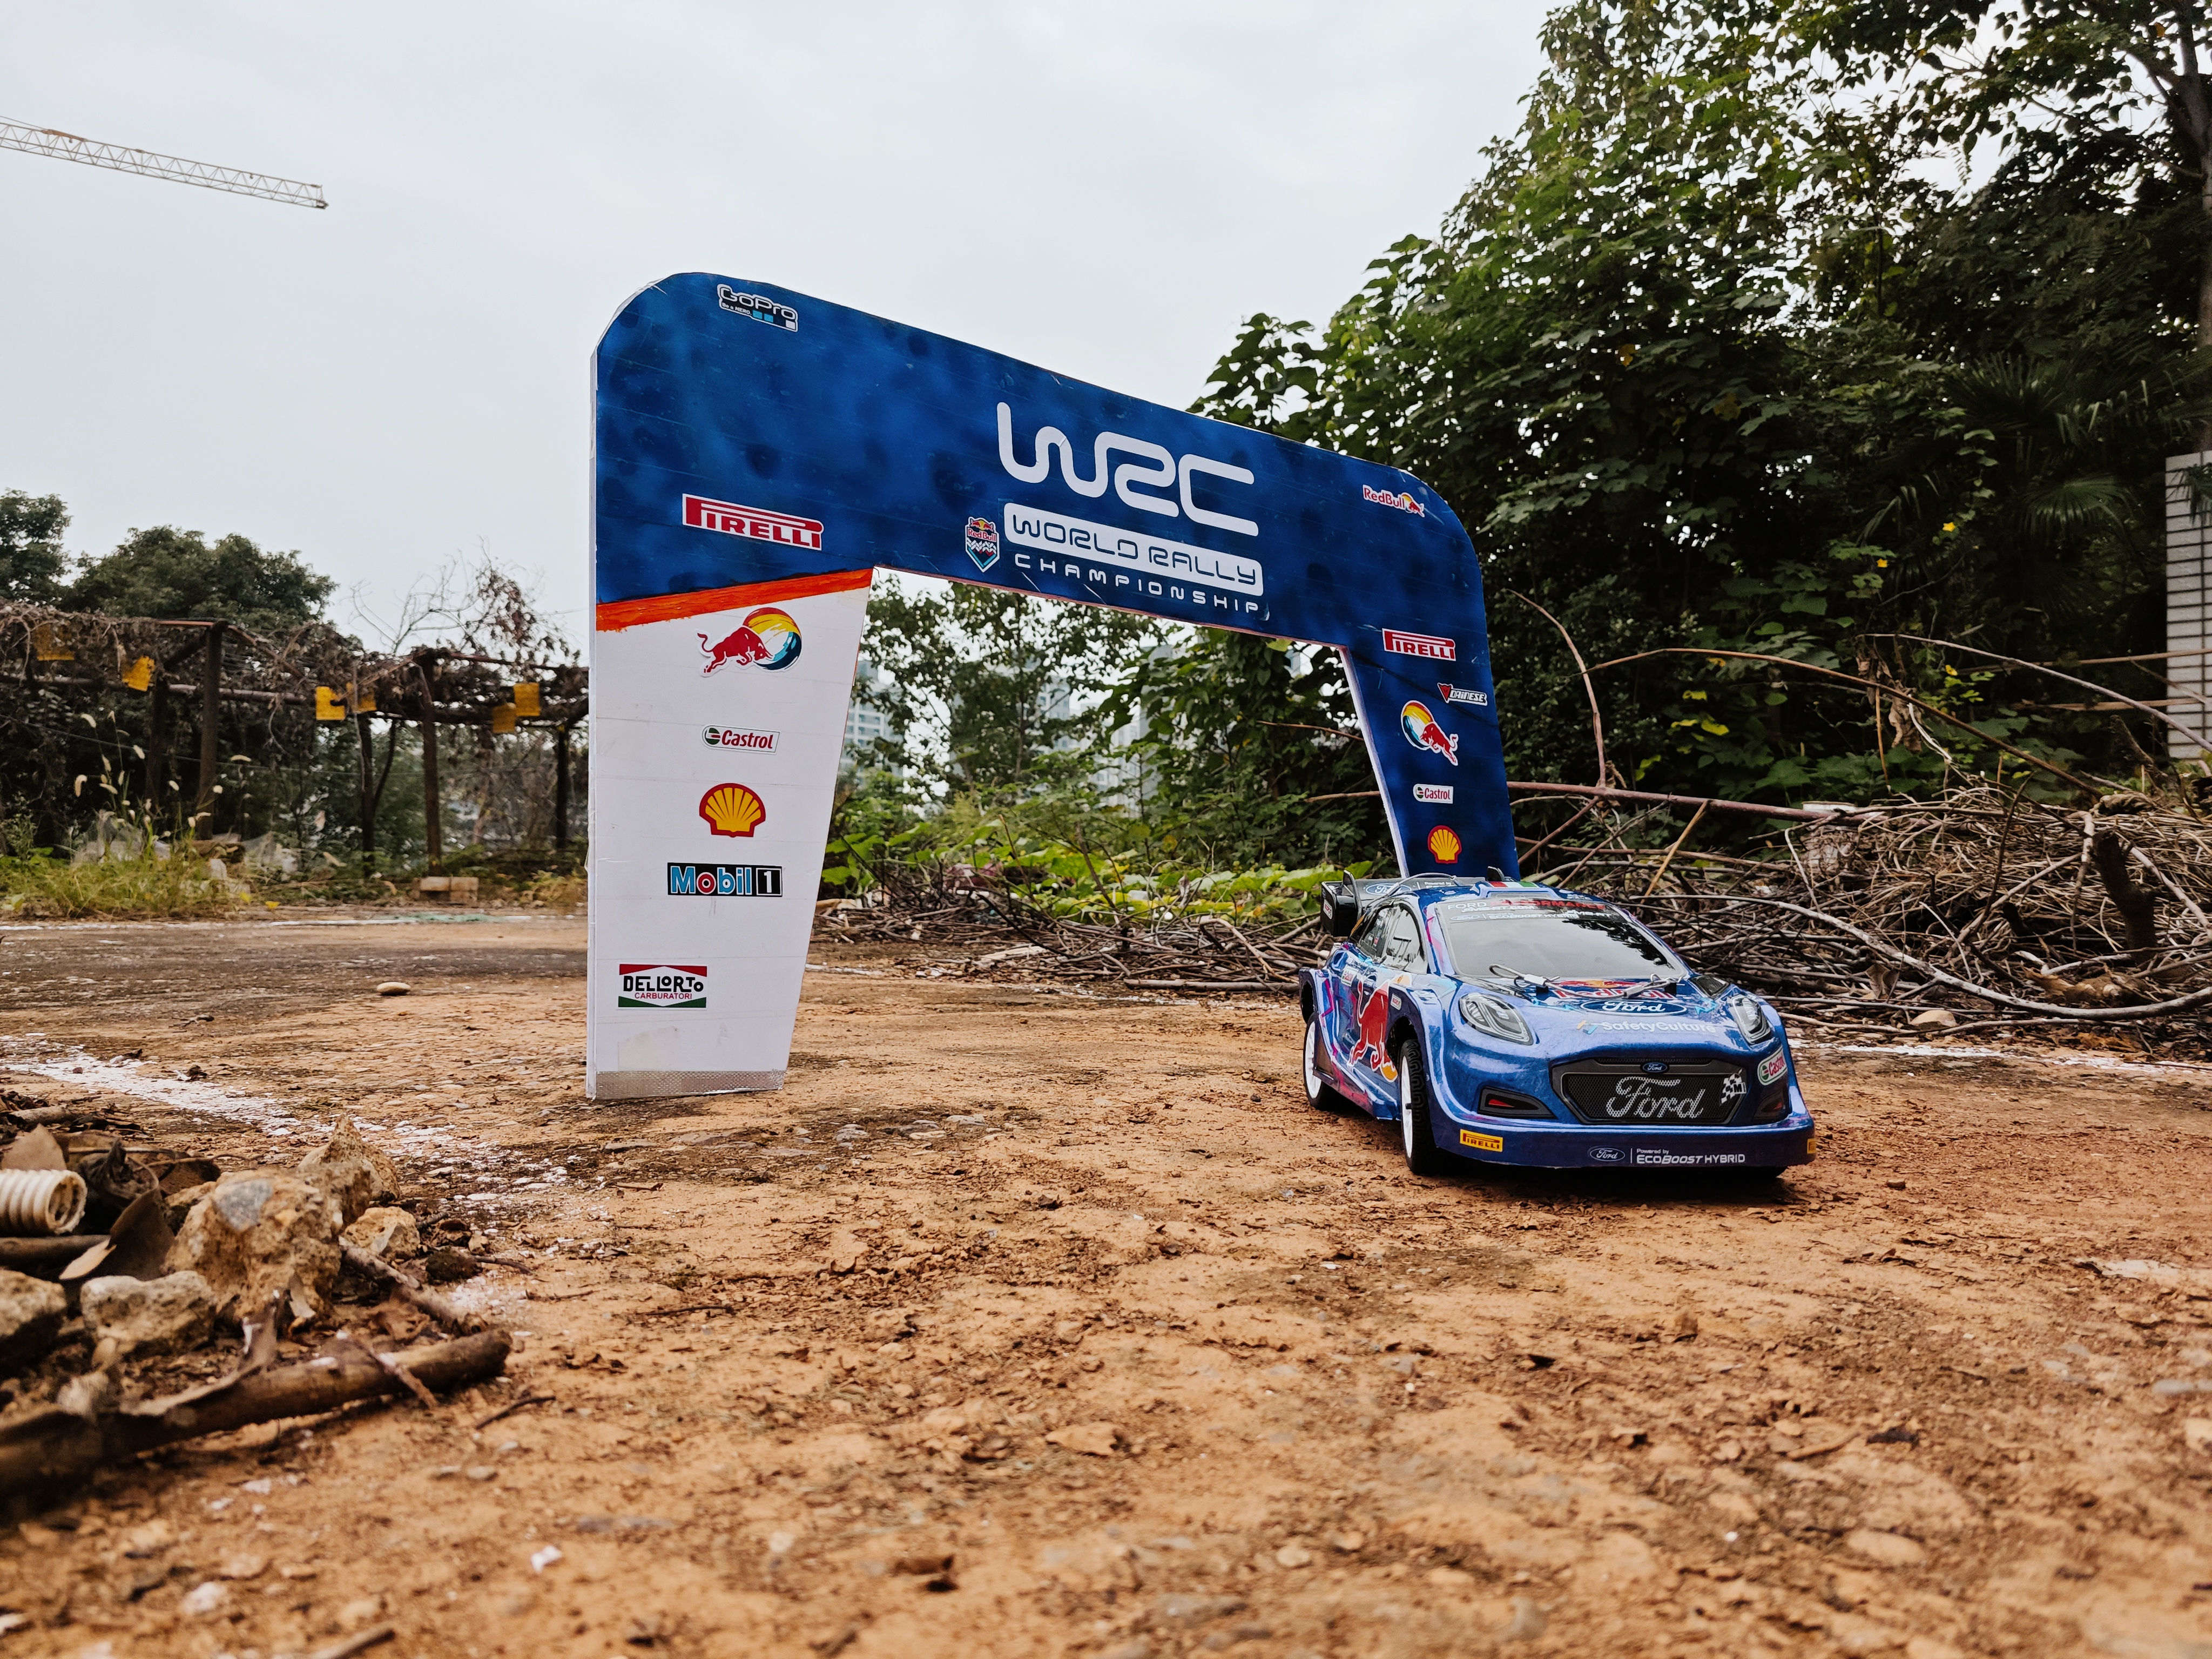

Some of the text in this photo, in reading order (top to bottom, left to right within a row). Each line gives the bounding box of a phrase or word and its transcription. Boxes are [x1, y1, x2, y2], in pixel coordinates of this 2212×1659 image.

[720, 287, 795, 320] GoPro
[997, 402, 1259, 536] WRC
[686, 496, 824, 549] PIRELLI
[1013, 514, 1256, 586] WORLD RALLY
[1015, 553, 1258, 613] CHAMPIONSHIP
[1384, 630, 1455, 659] PIRELLI
[721, 730, 774, 749] Castrol
[1425, 787, 1451, 800] Castrol
[670, 866, 772, 895] Mobil 1
[1447, 901, 1487, 910] FORD
[1602, 1001, 1665, 1012] Ford
[1606, 1076, 1705, 1118] Ford
[1462, 1132, 1500, 1149] PIRELLI
[1596, 1149, 1618, 1159] Ford
[1704, 1154, 1745, 1163] HYBRID
